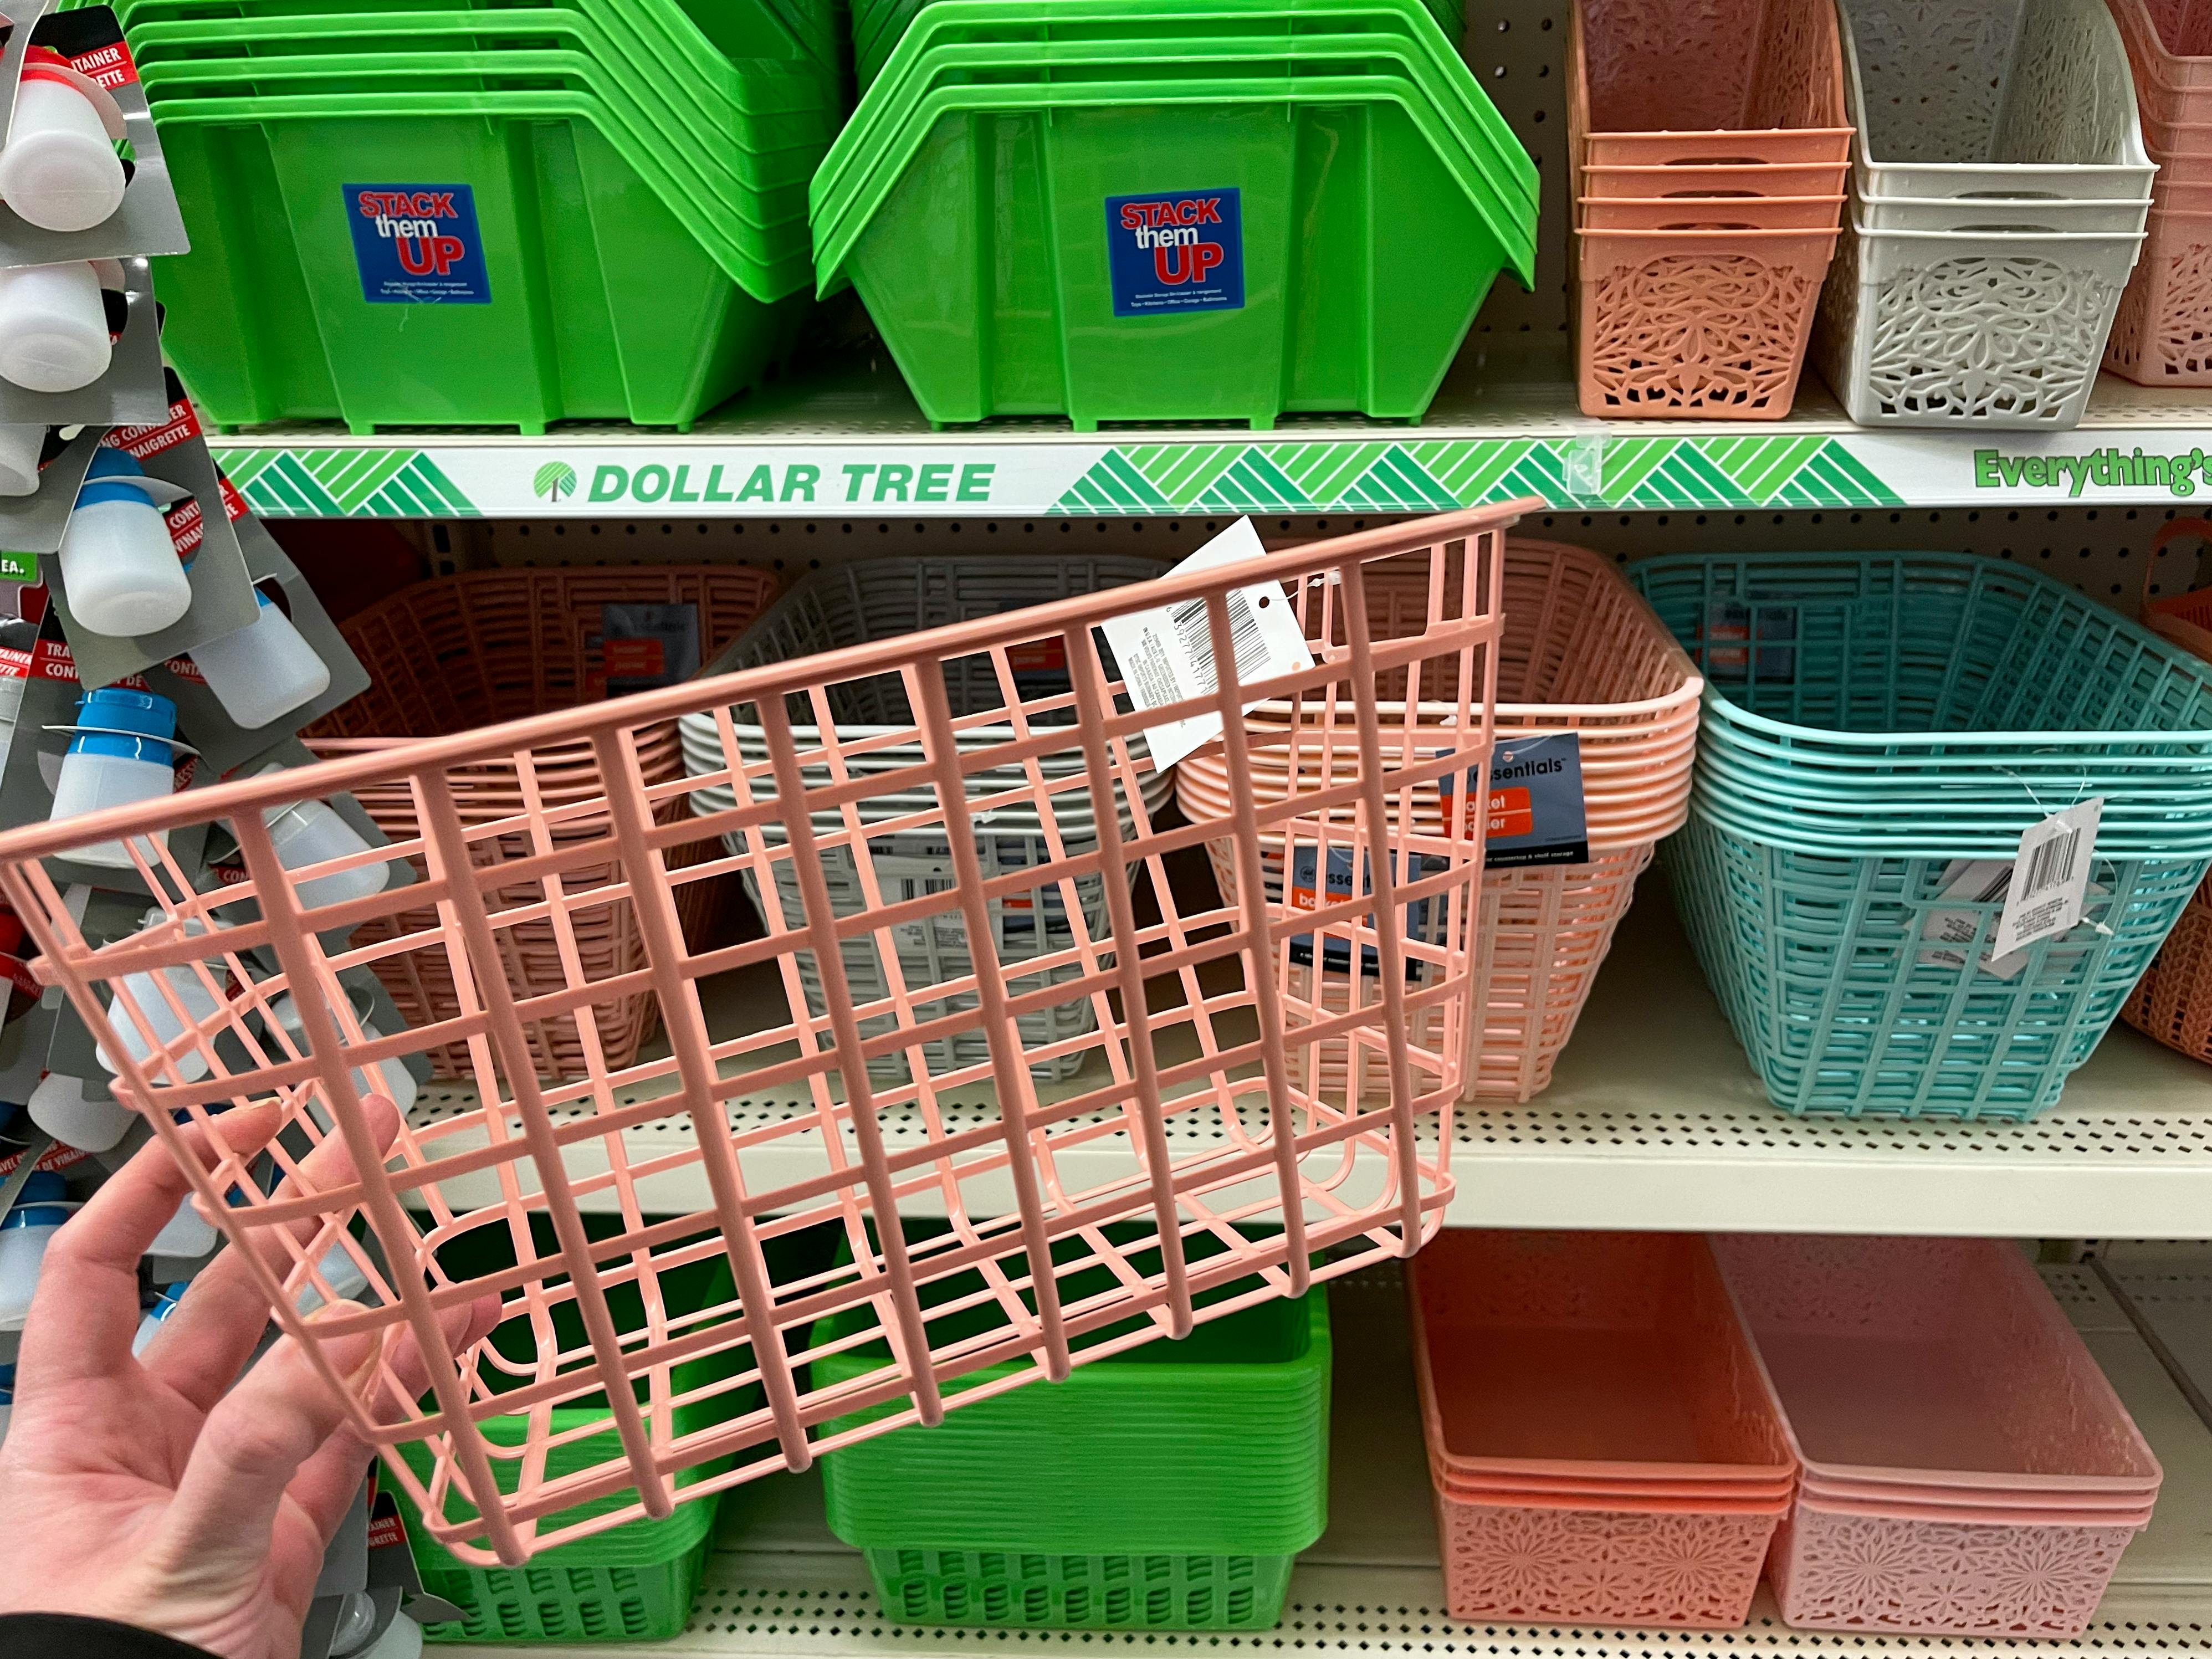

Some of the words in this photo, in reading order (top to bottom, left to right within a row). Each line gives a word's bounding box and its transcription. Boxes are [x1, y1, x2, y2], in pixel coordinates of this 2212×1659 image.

[70, 47, 122, 72] TAINER
[359, 191, 459, 218] STACK
[1120, 198, 1222, 230] STACK
[375, 213, 439, 238] them
[1135, 225, 1199, 249] them
[396, 235, 465, 275] UP
[1154, 242, 1224, 285] UP
[129, 423, 191, 458] NAIGRETTE
[587, 463, 822, 502] DOLLAR
[842, 463, 996, 502] TREE
[1, 559, 24, 574] EA.
[47, 642, 71, 658] TRA
[1174, 622, 1194, 654] 39277
[1473, 757, 1563, 783] sentials
